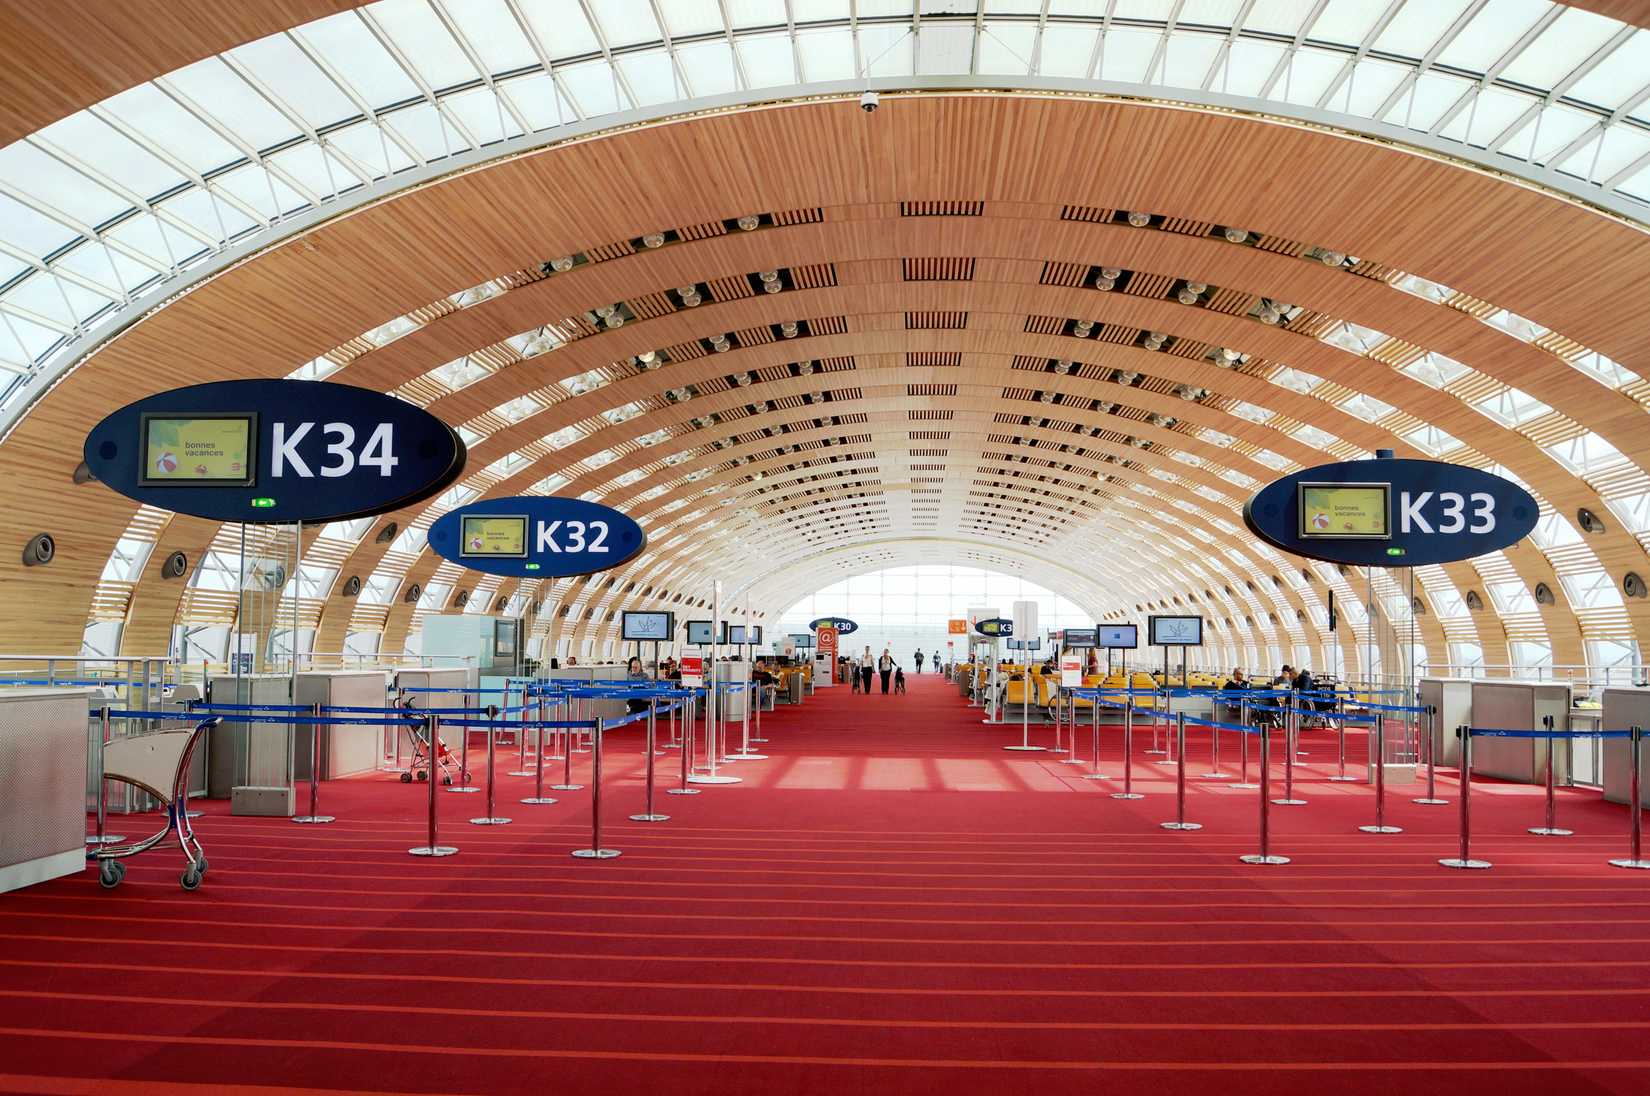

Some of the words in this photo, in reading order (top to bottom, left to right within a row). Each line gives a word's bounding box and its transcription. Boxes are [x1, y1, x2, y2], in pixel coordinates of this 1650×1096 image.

[184, 440, 216, 449] bonnes
[184, 449, 224, 457] vacances
[271, 422, 398, 477] K34
[1400, 491, 1496, 534] K33
[536, 520, 609, 553] K32
[833, 622, 852, 631] K30
[1000, 623, 1012, 632] K3
